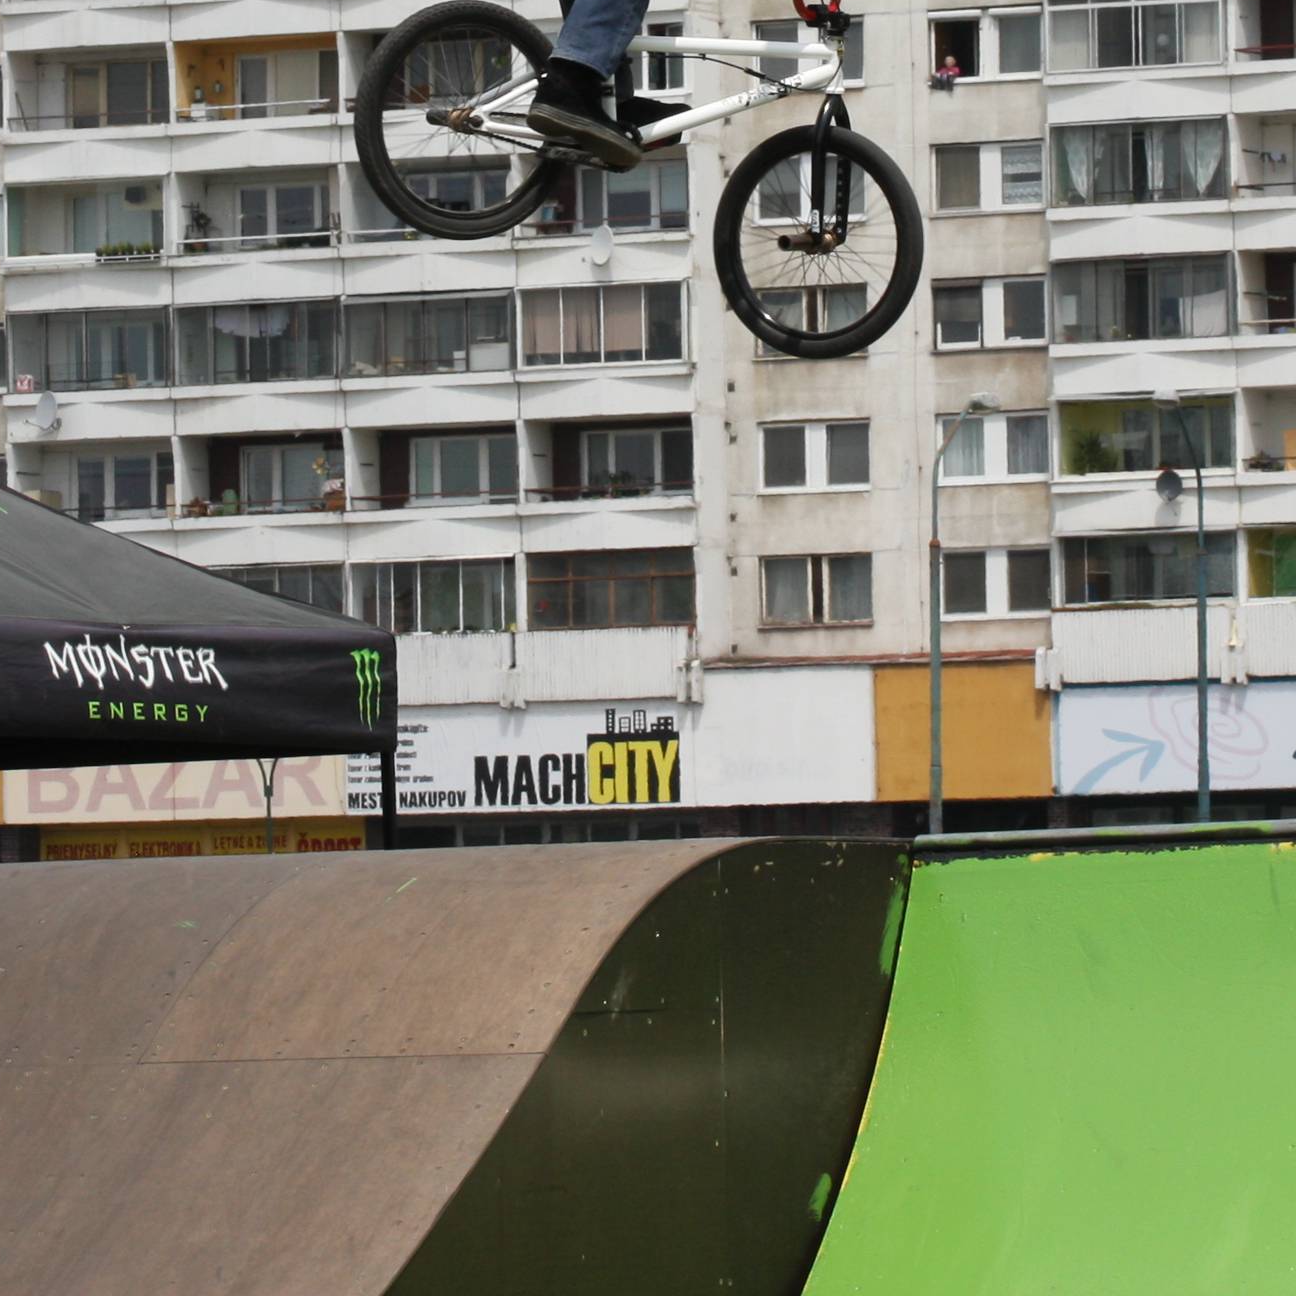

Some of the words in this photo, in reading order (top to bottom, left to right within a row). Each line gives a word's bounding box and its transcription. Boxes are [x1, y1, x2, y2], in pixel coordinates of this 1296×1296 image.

[42, 634, 229, 691] MONSTER
[88, 700, 209, 723] ENERGY
[27, 756, 326, 813] BAZAR
[347, 792, 384, 809] MEST
